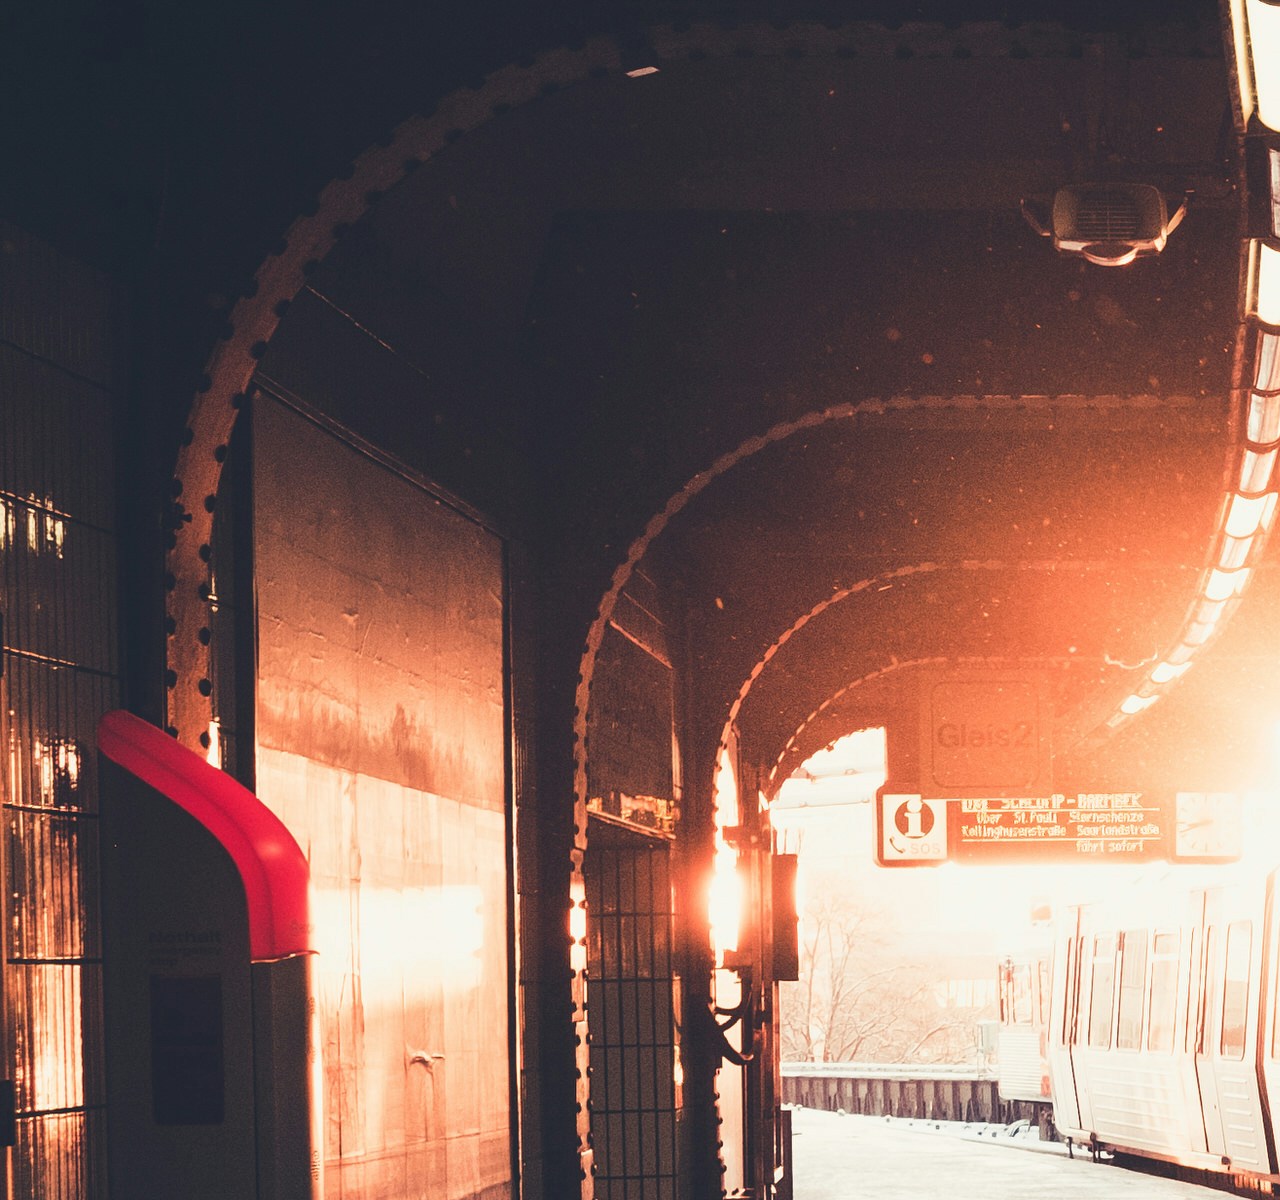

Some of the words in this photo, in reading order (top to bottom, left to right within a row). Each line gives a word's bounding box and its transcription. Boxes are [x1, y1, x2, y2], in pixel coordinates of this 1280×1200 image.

[936, 722, 1011, 748] Gleis
[1013, 720, 1035, 748] 2
[1068, 810, 1144, 823] Sternschenze
[961, 825, 1066, 839] Kellinghusenstraße
[1077, 824, 1160, 837] Saarlandstraße
[910, 842, 941, 855] SOS
[1108, 840, 1143, 852] sofort
[149, 930, 222, 943] Nothalt
